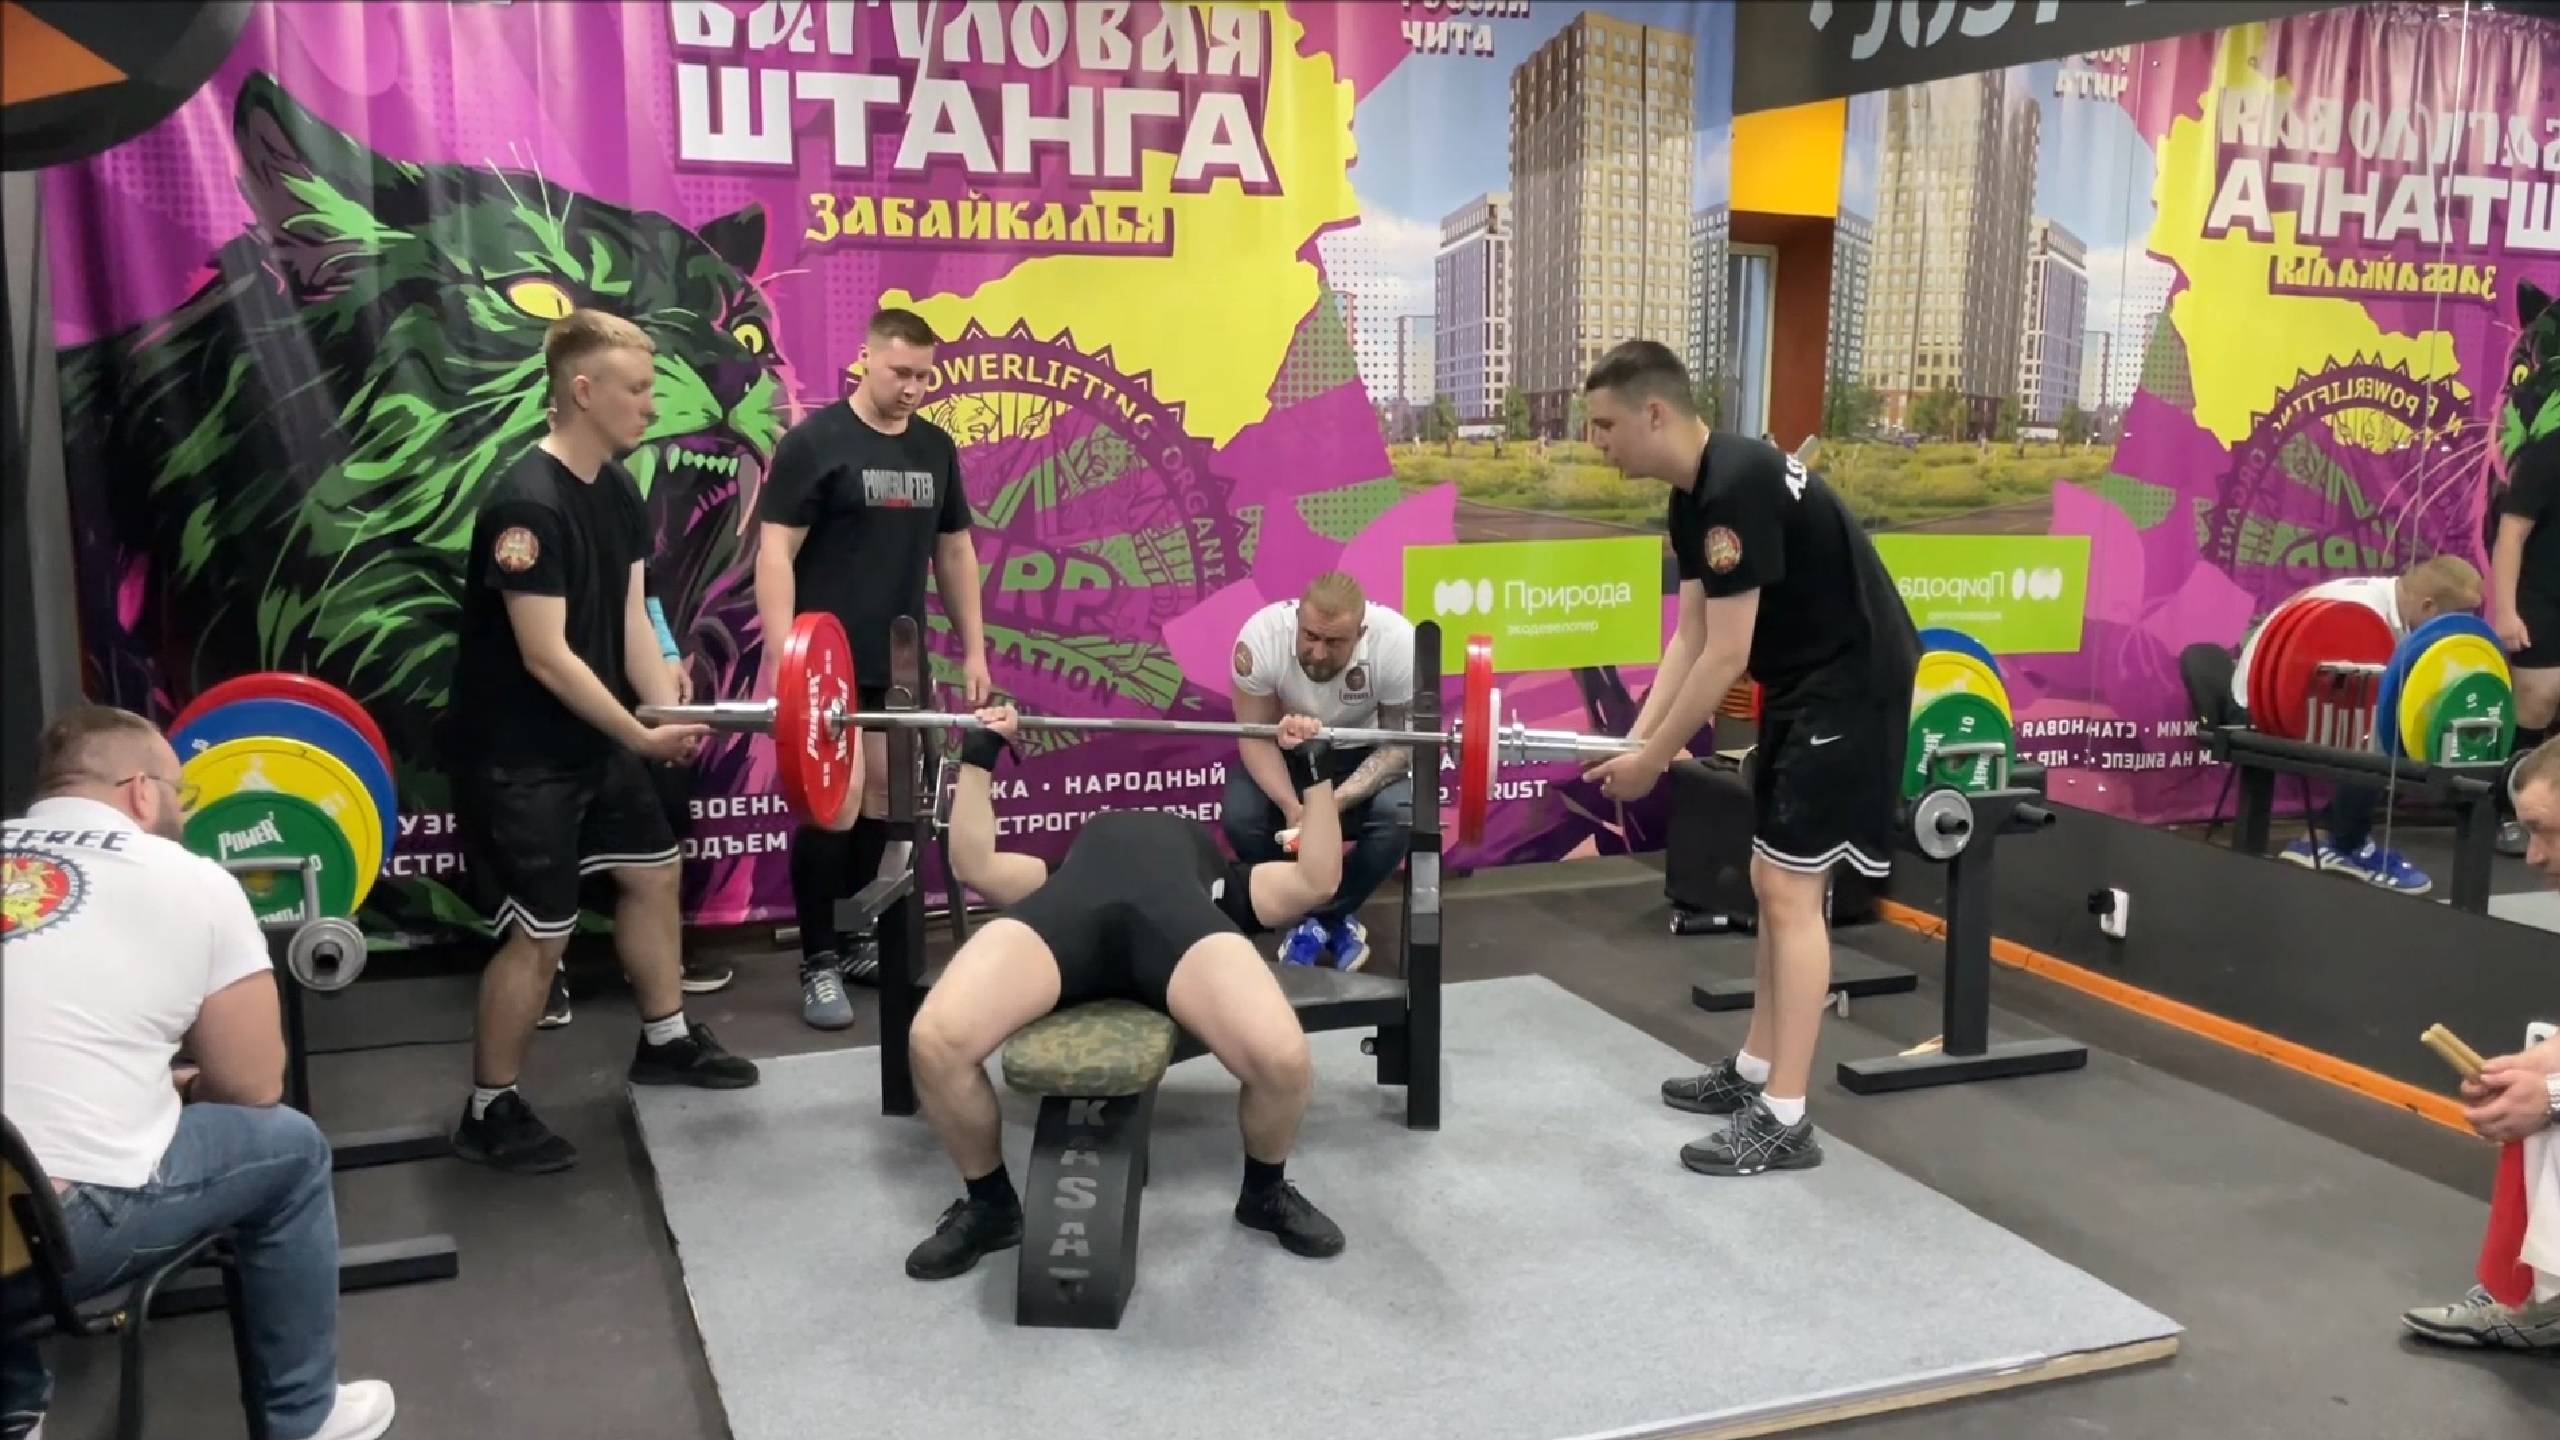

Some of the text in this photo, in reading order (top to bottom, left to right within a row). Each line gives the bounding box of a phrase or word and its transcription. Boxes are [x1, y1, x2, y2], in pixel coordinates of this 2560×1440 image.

[1402, 20, 1494, 52] ЧИТА
[677, 62, 1270, 183] ШТАНГА
[805, 188, 1166, 243] ЗАБАЙКАЛЬЯ
[926, 352, 1157, 439] OWERLIFTING
[1504, 580, 1632, 616] Природа
[1065, 762, 1226, 795] НАРОДНЫЙ
